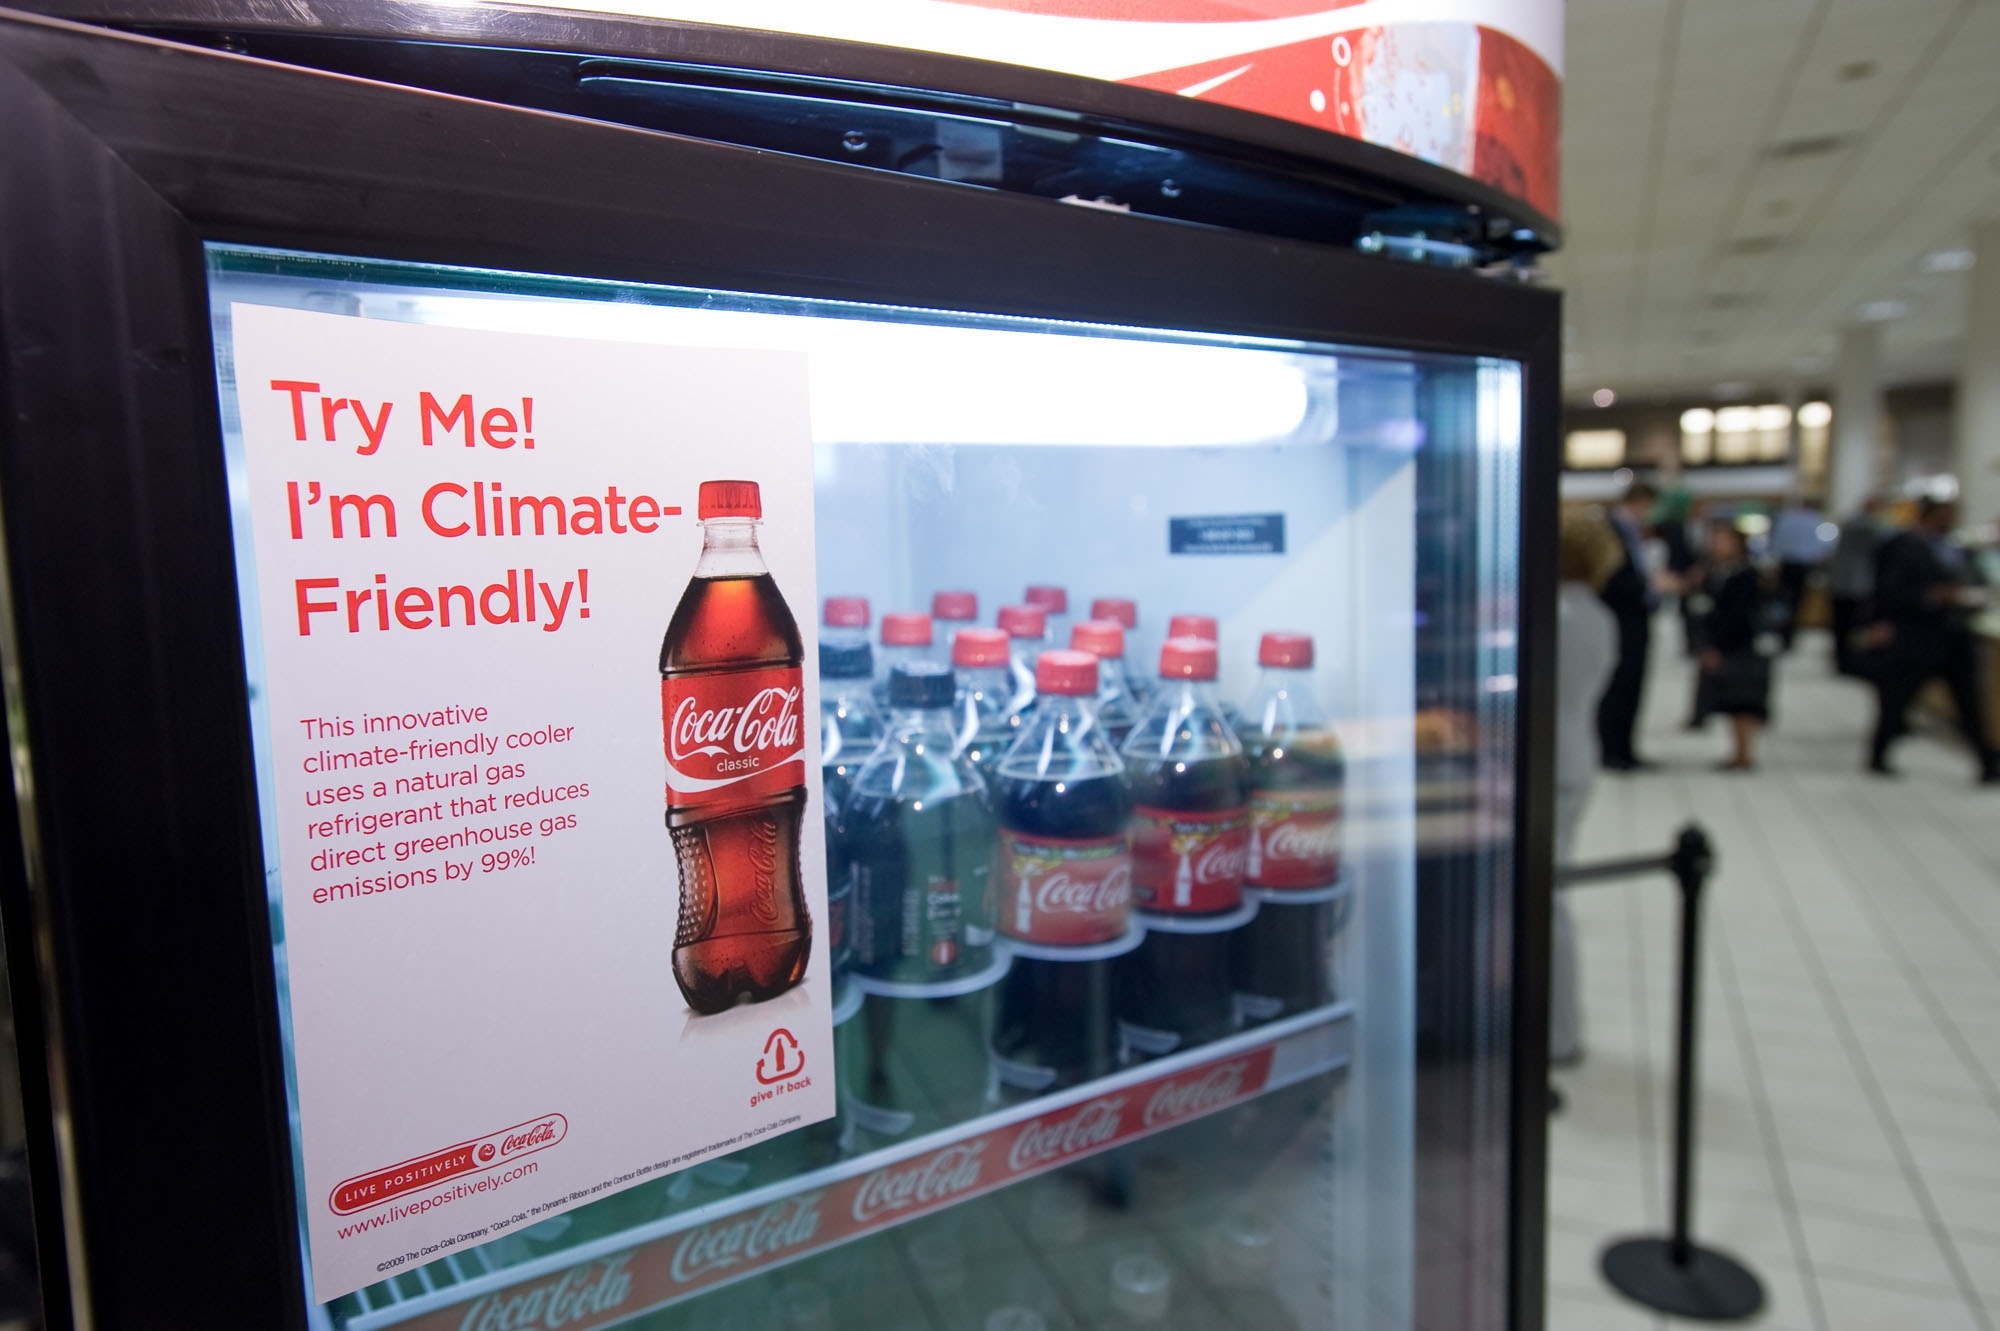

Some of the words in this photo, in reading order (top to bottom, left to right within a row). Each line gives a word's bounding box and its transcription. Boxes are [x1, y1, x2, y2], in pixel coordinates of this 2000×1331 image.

[270, 379, 394, 456] Try
[420, 390, 535, 450] Me!
[286, 480, 398, 540] I’m
[421, 480, 683, 538] Climate-
[295, 567, 591, 637] Friendly!
[300, 717, 355, 740] This
[363, 704, 488, 734] innovative
[303, 732, 499, 774] climate-friendly
[506, 724, 575, 749] cooler
[671, 686, 800, 761] Coca-Cola
[305, 782, 365, 806] uses
[372, 781, 387, 798] a
[395, 764, 478, 794] natural
[486, 762, 525, 786] gas
[716, 755, 760, 773] classic
[308, 801, 443, 840] refrigerant
[450, 793, 497, 818] that
[504, 782, 590, 810] reduces
[310, 842, 386, 872] direct
[394, 822, 532, 862] greenhouse
[539, 813, 577, 837] gas
[312, 867, 438, 904] emissions
[445, 860, 473, 881] by
[481, 846, 536, 874] 99%!
[750, 1090, 773, 1107] give
[776, 1084, 784, 1096] it
[787, 1076, 812, 1092] back
[1009, 1095, 1127, 1171] Coca-Cola
[337, 1161, 539, 1240] www.livepositively.com
[345, 1184, 377, 1203] LIVE
[384, 1154, 467, 1190] POSITIVELY
[406, 1250, 420, 1262] The
[420, 1237, 456, 1257] Coca-Cola
[531, 1206, 541, 1215] the
[542, 1195, 568, 1212] Dynamic
[569, 1188, 590, 1200] Ribbon
[590, 1183, 602, 1194] and
[603, 1178, 613, 1189] the
[613, 1172, 635, 1185] Contour
[636, 1165, 652, 1176] Bottle
[653, 1158, 671, 1171] design
[672, 1156, 681, 1164] are
[682, 1145, 707, 1161] registered
[708, 1136, 736, 1151] trademarks
[743, 1132, 753, 1140] The
[753, 1121, 778, 1136] Coca-Cola
[852, 1134, 991, 1221] Coca-Cola
[670, 1193, 827, 1283] Coca-Cola
